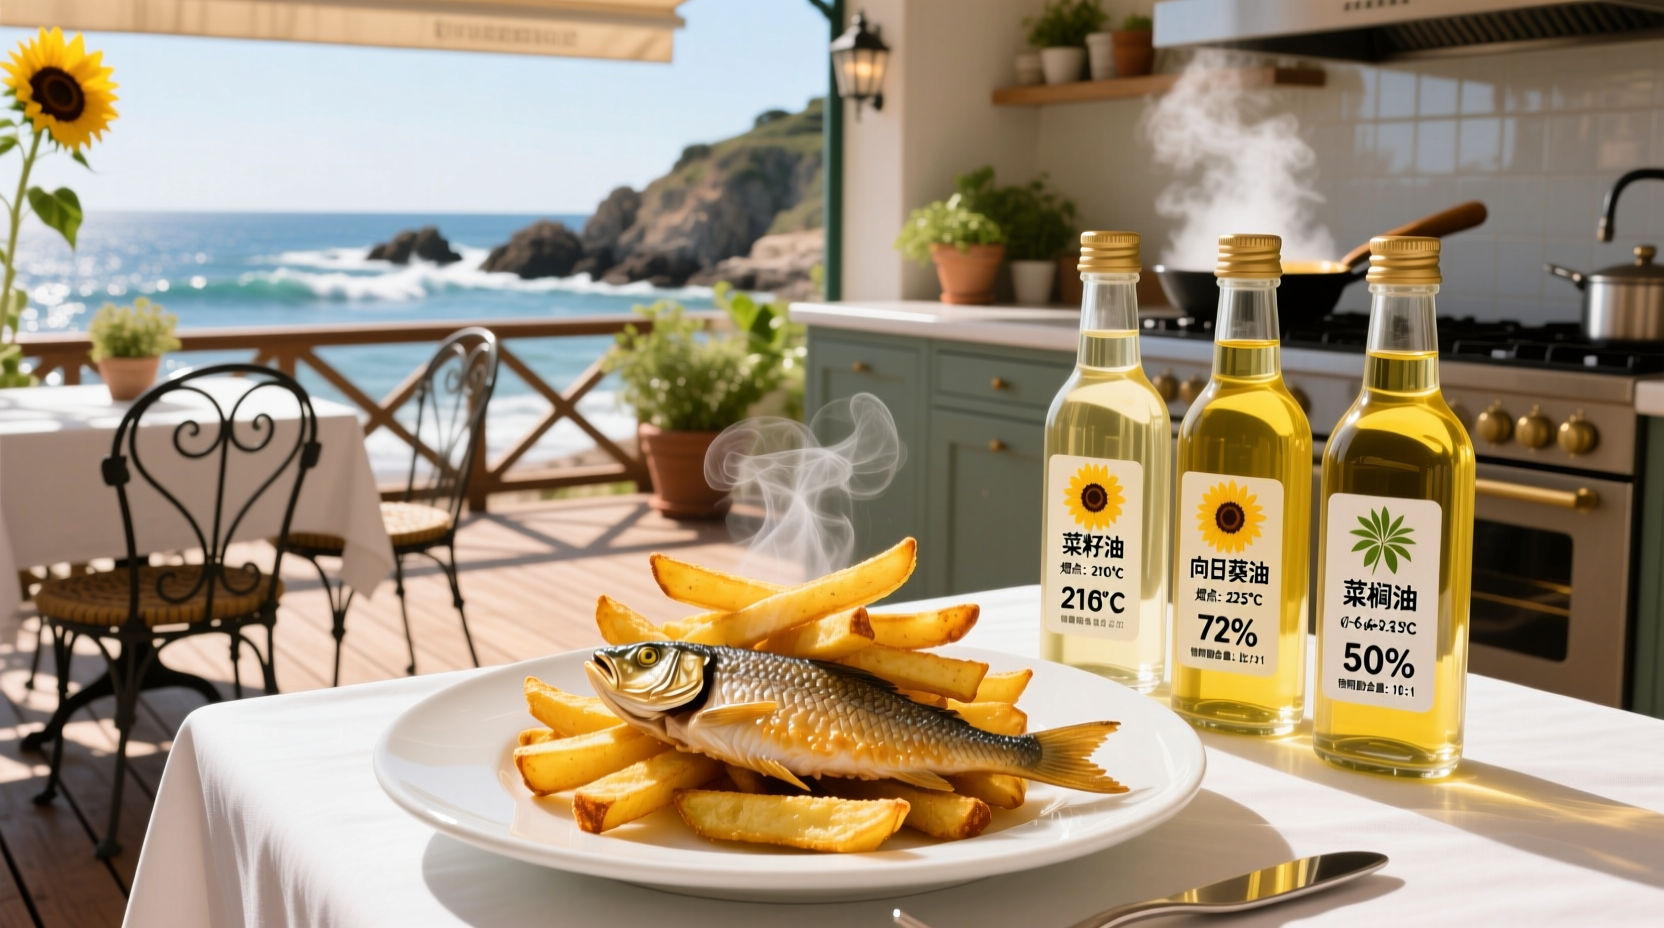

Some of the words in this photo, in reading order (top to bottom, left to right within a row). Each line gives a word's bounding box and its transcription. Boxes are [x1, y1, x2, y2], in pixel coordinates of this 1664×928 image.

[1062, 531, 1124, 559] 菜籽油
[1190, 555, 1269, 585] 向日葵油
[1061, 586, 1125, 614] 216°C
[1225, 592, 1263, 606] 225°C
[1198, 613, 1258, 647] 72%
[1343, 642, 1415, 678] 50%
